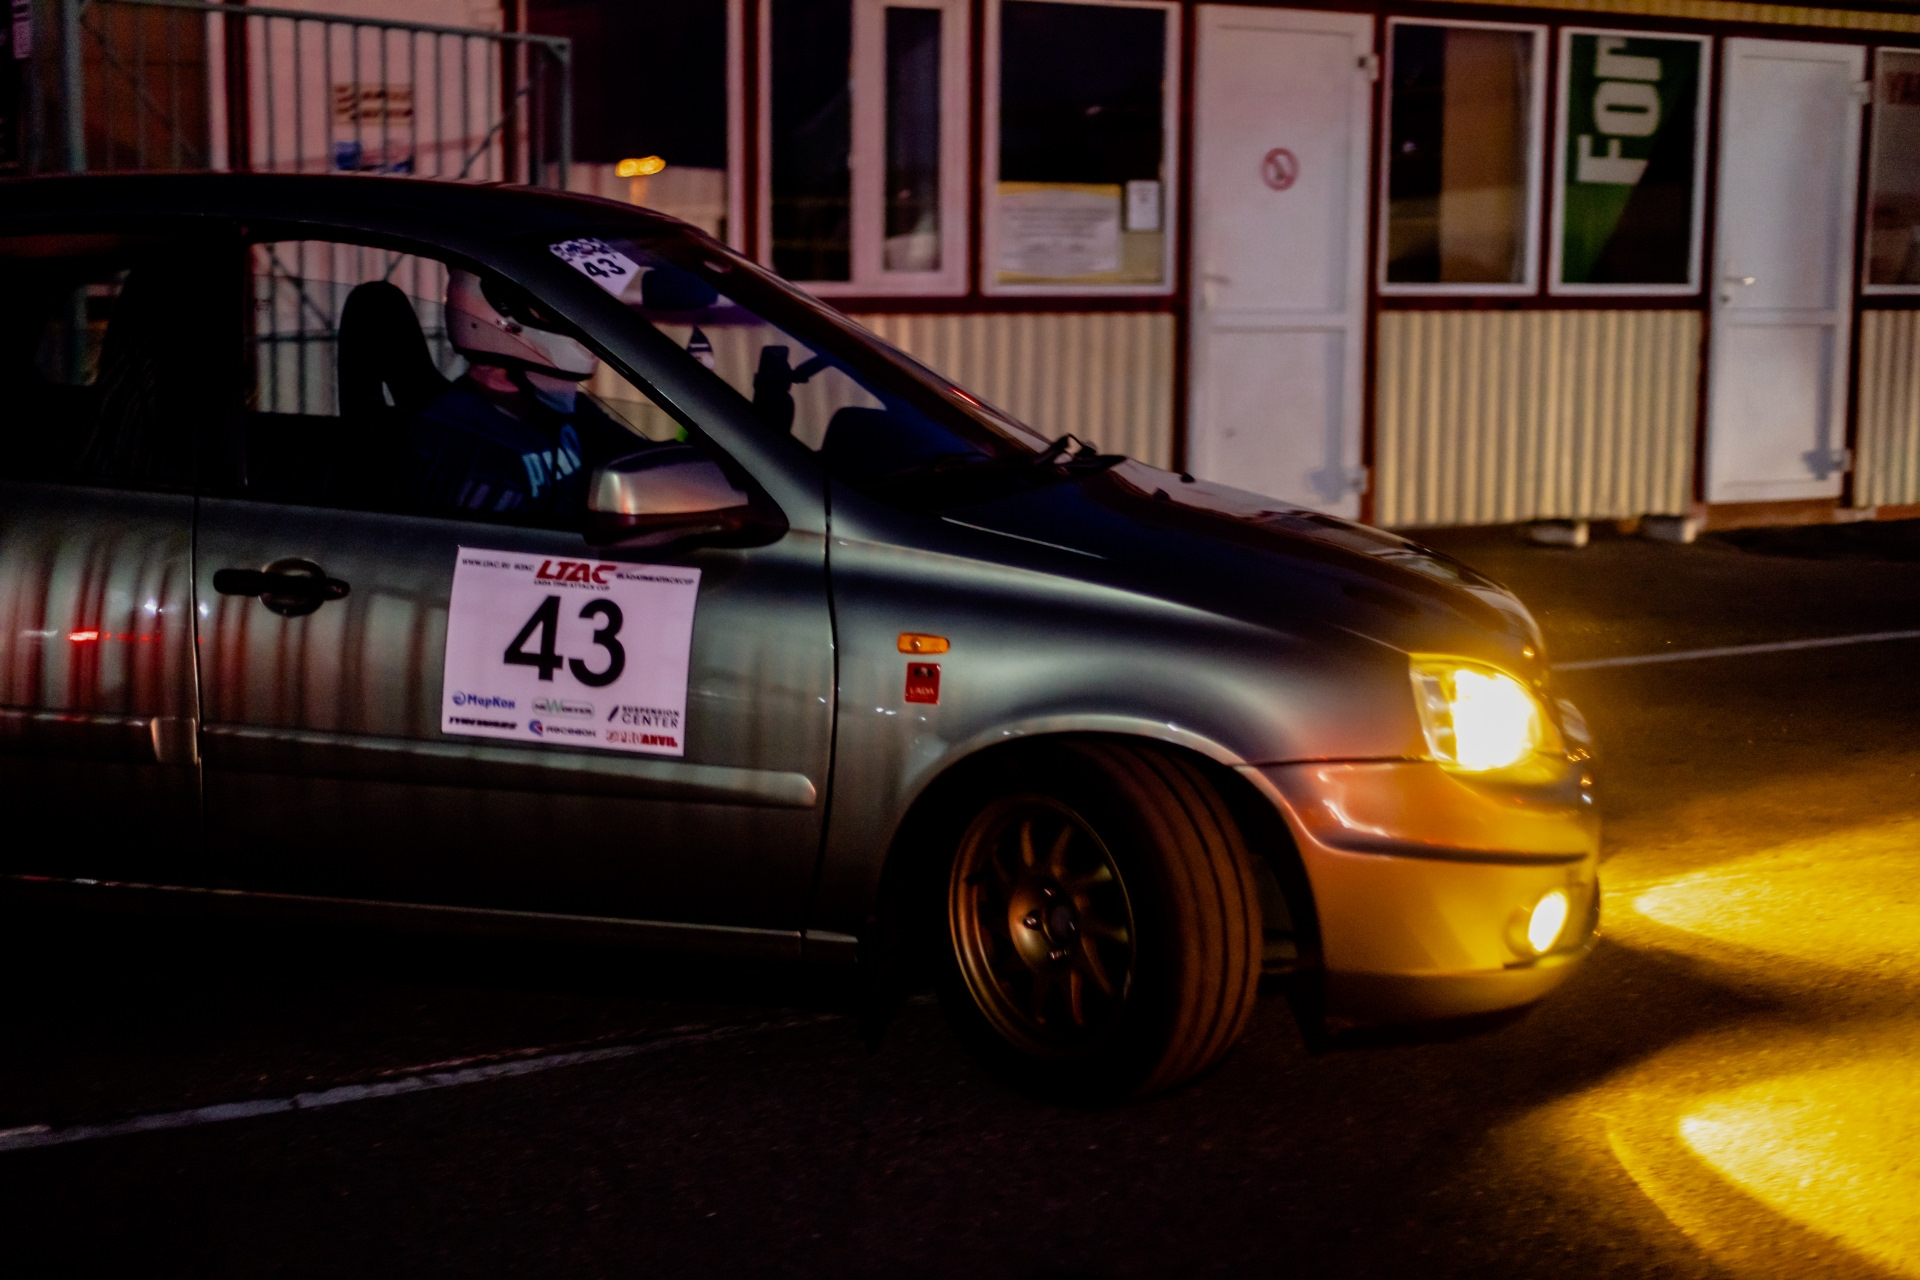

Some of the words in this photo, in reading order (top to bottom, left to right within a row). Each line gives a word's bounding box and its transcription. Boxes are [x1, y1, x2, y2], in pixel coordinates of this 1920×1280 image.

[583, 258, 626, 278] 43
[536, 559, 617, 585] LTAC
[503, 594, 626, 687] 43
[621, 713, 679, 729] CENTER
[622, 704, 680, 718] SUSPENSION
